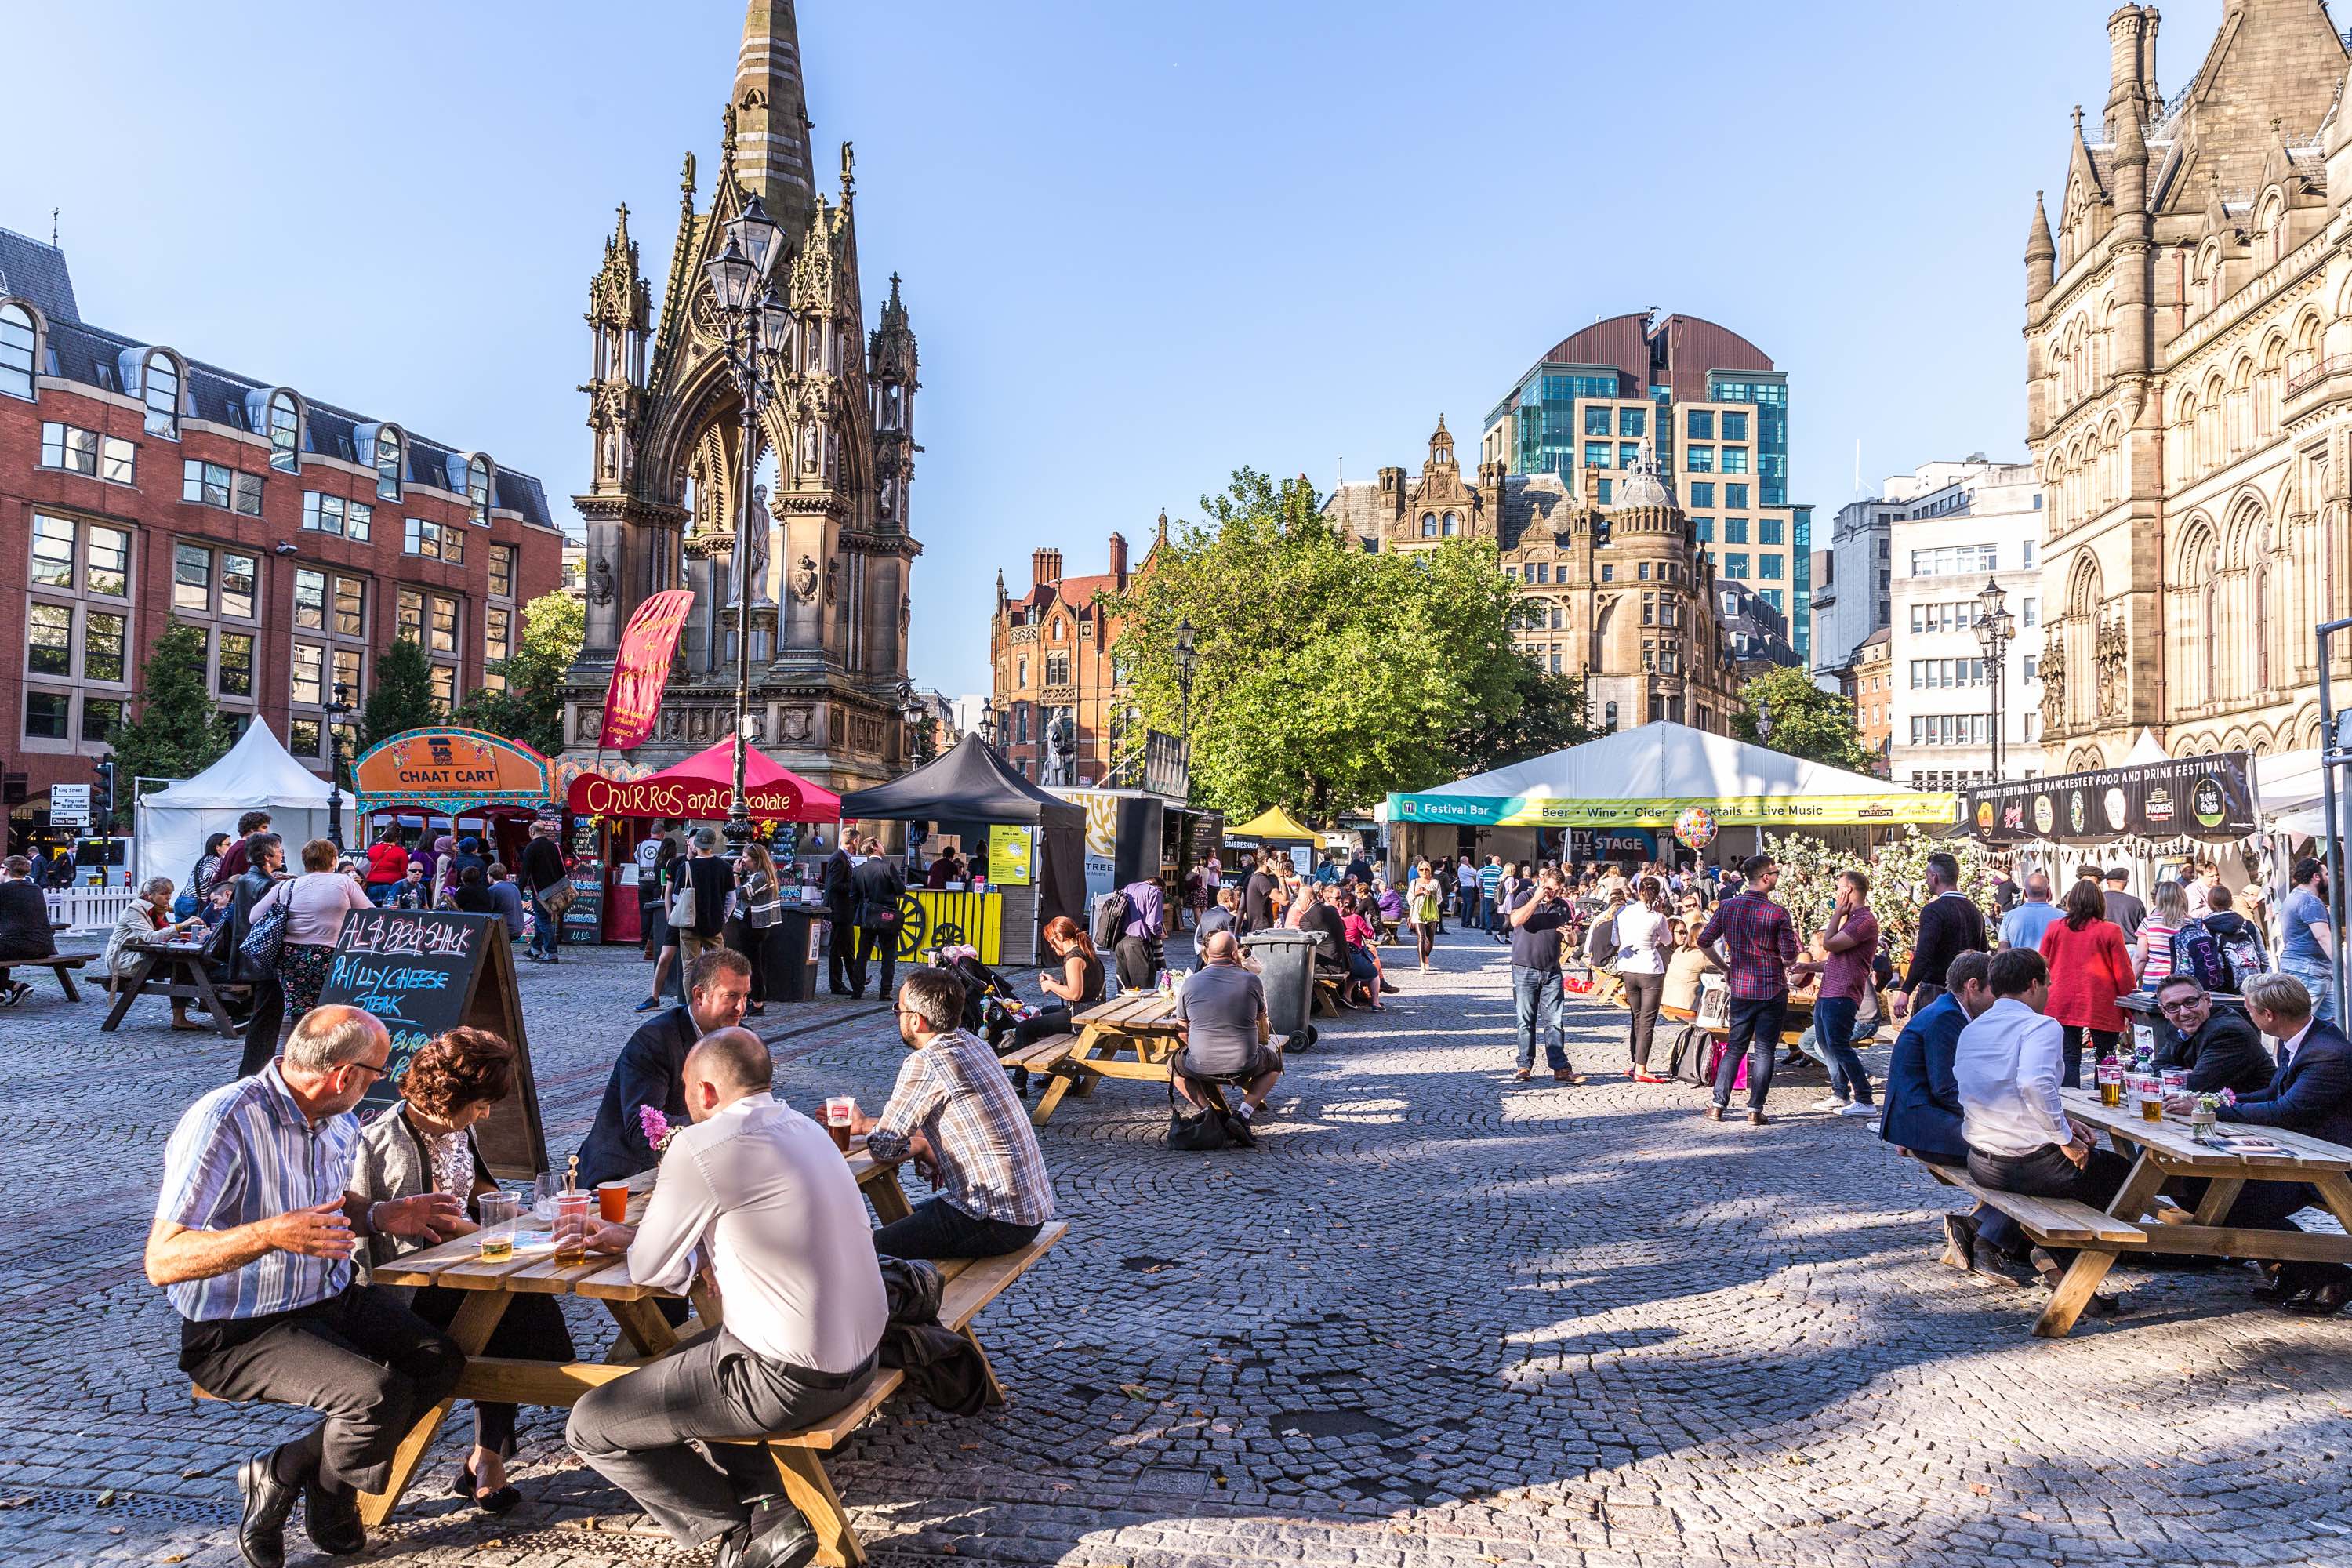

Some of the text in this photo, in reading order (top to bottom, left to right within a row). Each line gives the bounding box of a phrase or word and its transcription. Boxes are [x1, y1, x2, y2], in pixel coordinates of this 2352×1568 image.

[612, 706, 647, 720] HOME MADE
[615, 716, 637, 728] SPANISH
[608, 727, 634, 738] CHURROS
[399, 771, 495, 782] CHAAT CART
[1976, 760, 2227, 800] PROUDLY SERVING THE MANCHESTER FOOD AND DRINK FESTIVAL
[688, 788, 717, 815] and
[1425, 804, 1490, 815] Festival Bar
[1543, 808, 1569, 817] Beer
[1588, 807, 1617, 817] Wine
[1635, 806, 1668, 817] Cider
[1761, 806, 1785, 815] Live
[1789, 805, 1823, 815] Music
[1558, 831, 1592, 843] CTY
[1225, 840, 1259, 849] CRABBIESHACK
[1595, 838, 1642, 850] STAGE
[383, 917, 424, 956] BBQ
[424, 920, 474, 956] SHACK
[2197, 942, 2218, 985] animal
[330, 955, 452, 993] PHILLY CHEESE
